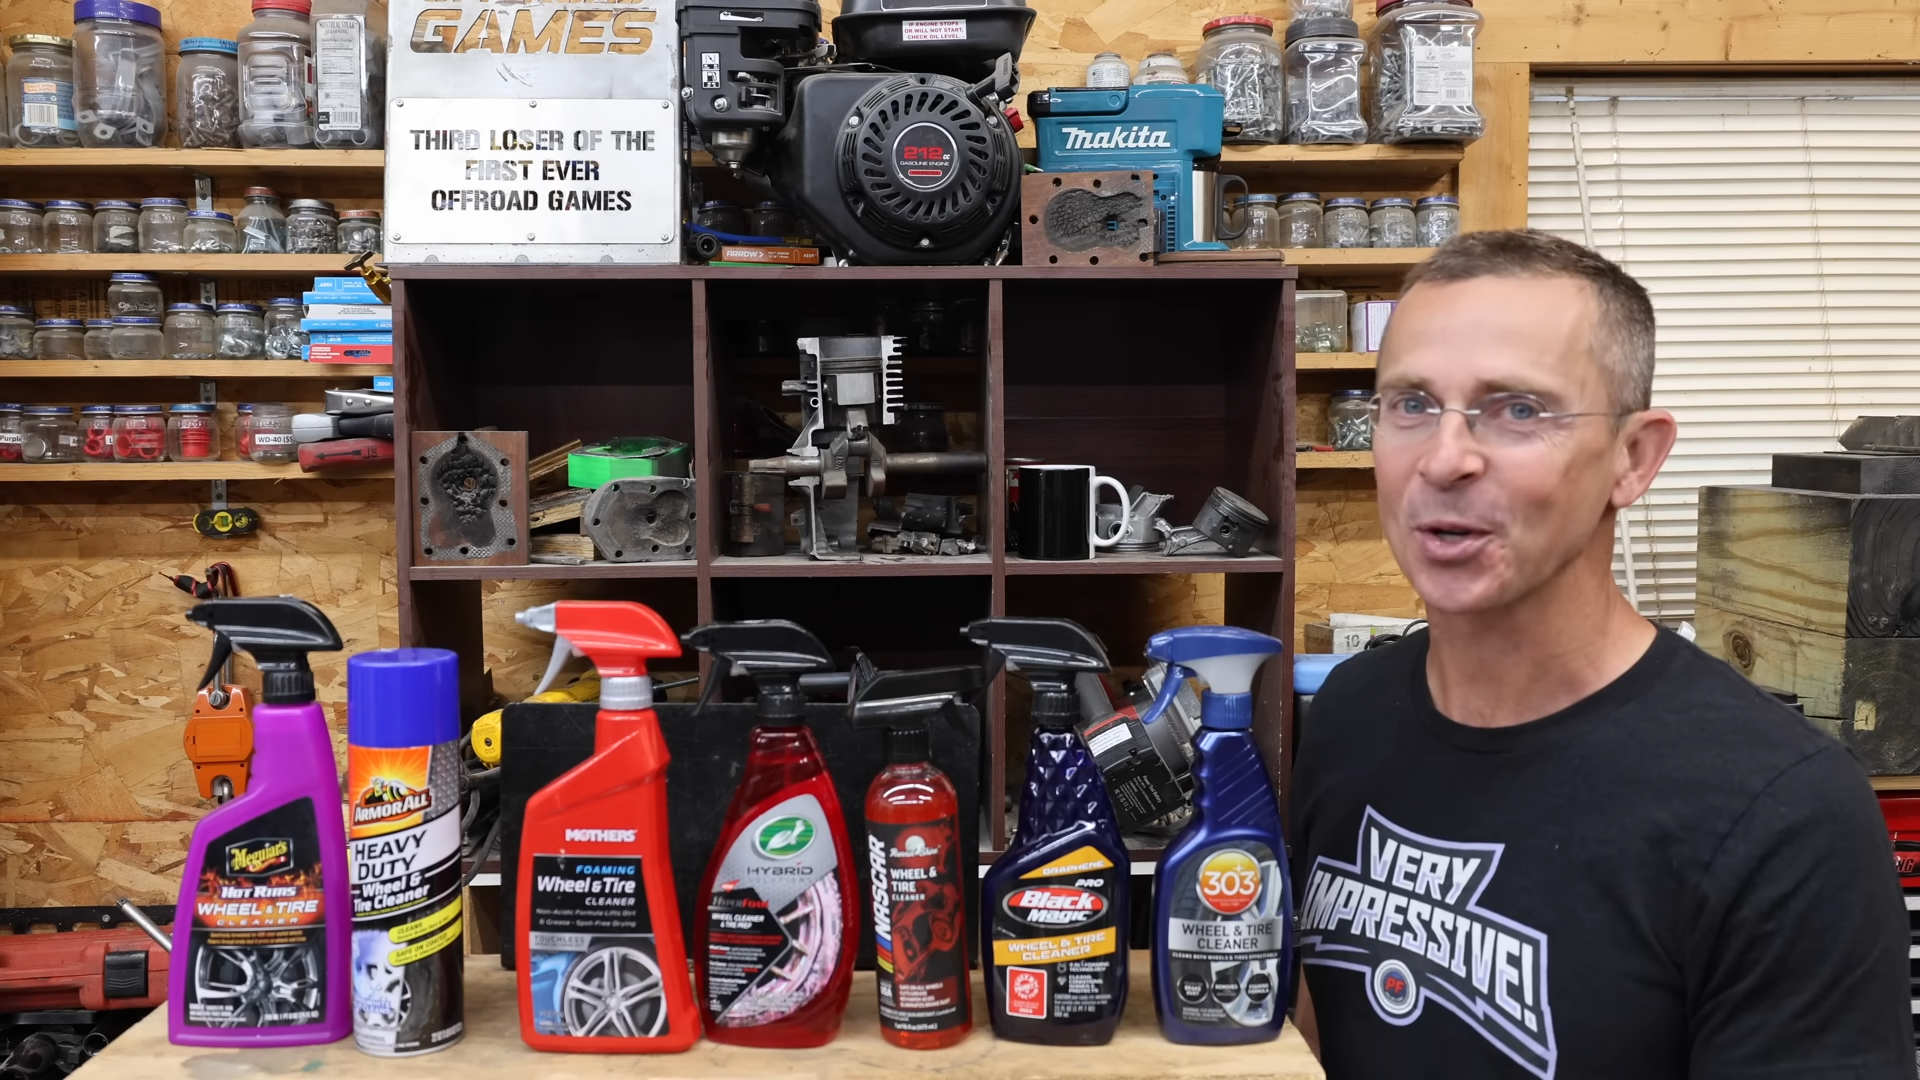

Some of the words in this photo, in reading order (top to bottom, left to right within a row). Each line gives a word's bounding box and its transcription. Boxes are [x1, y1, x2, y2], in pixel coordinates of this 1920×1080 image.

[410, 9, 657, 55] GAMES
[409, 130, 480, 150] THIRD
[490, 129, 564, 150] LOSER
[574, 130, 602, 150] OF
[610, 130, 655, 151] THE
[903, 146, 943, 160] 212
[465, 160, 533, 181] FIRST
[542, 160, 600, 181] EVER
[431, 189, 538, 211] OFFROAD
[547, 189, 632, 211] GAMES
[726, 250, 758, 258] ARROW
[1344, 634, 1360, 648] 10
[565, 829, 636, 842] MOTHERS
[355, 829, 427, 862] HEAVY
[358, 853, 418, 881] DUTY
[575, 865, 636, 875] FOAMING
[747, 865, 813, 875] HYBRID
[890, 868, 927, 880] WHEEL
[929, 866, 937, 877] &
[1042, 860, 1105, 876] GRAPHENE
[1370, 826, 1482, 905] VERY
[362, 876, 408, 898] Wheel
[410, 872, 422, 887] &
[537, 875, 591, 893] Wheel
[591, 880, 602, 893] &
[602, 877, 636, 893] Tire
[868, 834, 892, 942] NASCAR
[891, 881, 916, 893] TIRE
[1075, 878, 1105, 887] PRO
[1203, 871, 1256, 896] 303
[353, 898, 372, 913] Tire
[373, 884, 430, 910] Cleaner
[585, 897, 636, 906] CLEANER
[892, 893, 925, 901] CLEANER
[1019, 890, 1096, 910] Black
[197, 902, 262, 916] WHEEL
[265, 905, 273, 914] &
[275, 900, 319, 914] TIRE
[575, 908, 603, 917] Formula
[216, 917, 299, 926] CLEANER
[546, 918, 571, 926] Grease
[575, 919, 611, 927] Spot-Free
[612, 919, 636, 928] Drying
[711, 912, 733, 920] WHEEL
[733, 914, 765, 922] CLEANER
[1027, 909, 1090, 924] Magic
[1181, 923, 1230, 937] WHEEL
[1233, 925, 1242, 937] &
[1246, 923, 1273, 936] TIRE
[534, 935, 585, 943] TOUCHLESS
[1008, 941, 1057, 952] WHEEL
[1060, 939, 1070, 948] &
[1074, 932, 1106, 944] TIRE
[1197, 938, 1259, 950] CLEANER
[1022, 945, 1092, 961] CLEANER
[1300, 869, 1538, 1033] IMPRESSIVE!
[1384, 976, 1407, 994] PF
